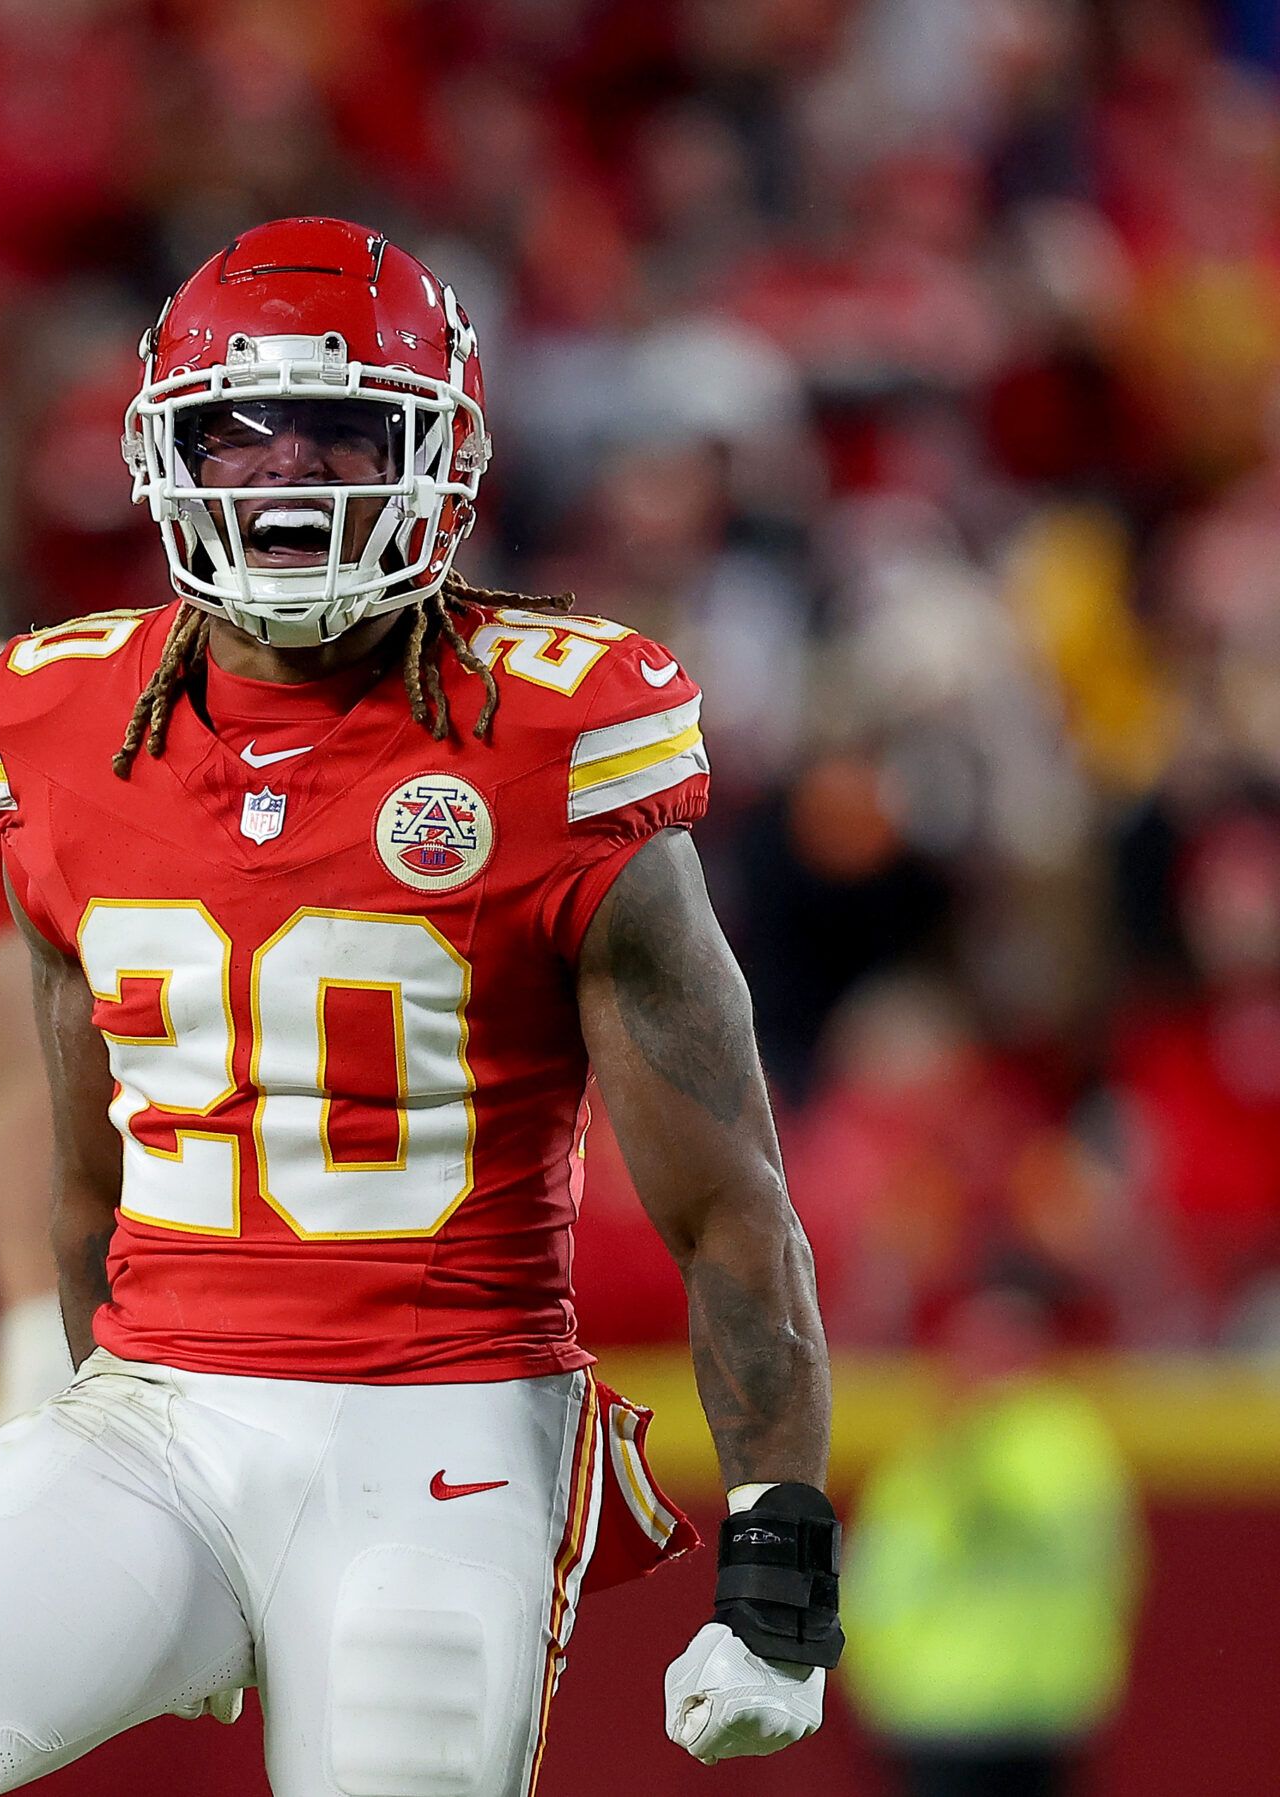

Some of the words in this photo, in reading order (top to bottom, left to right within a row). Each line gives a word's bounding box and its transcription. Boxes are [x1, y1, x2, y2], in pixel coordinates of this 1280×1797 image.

[460, 609, 639, 698] 20
[250, 812, 276, 832] NFL
[76, 897, 476, 1240] 20
